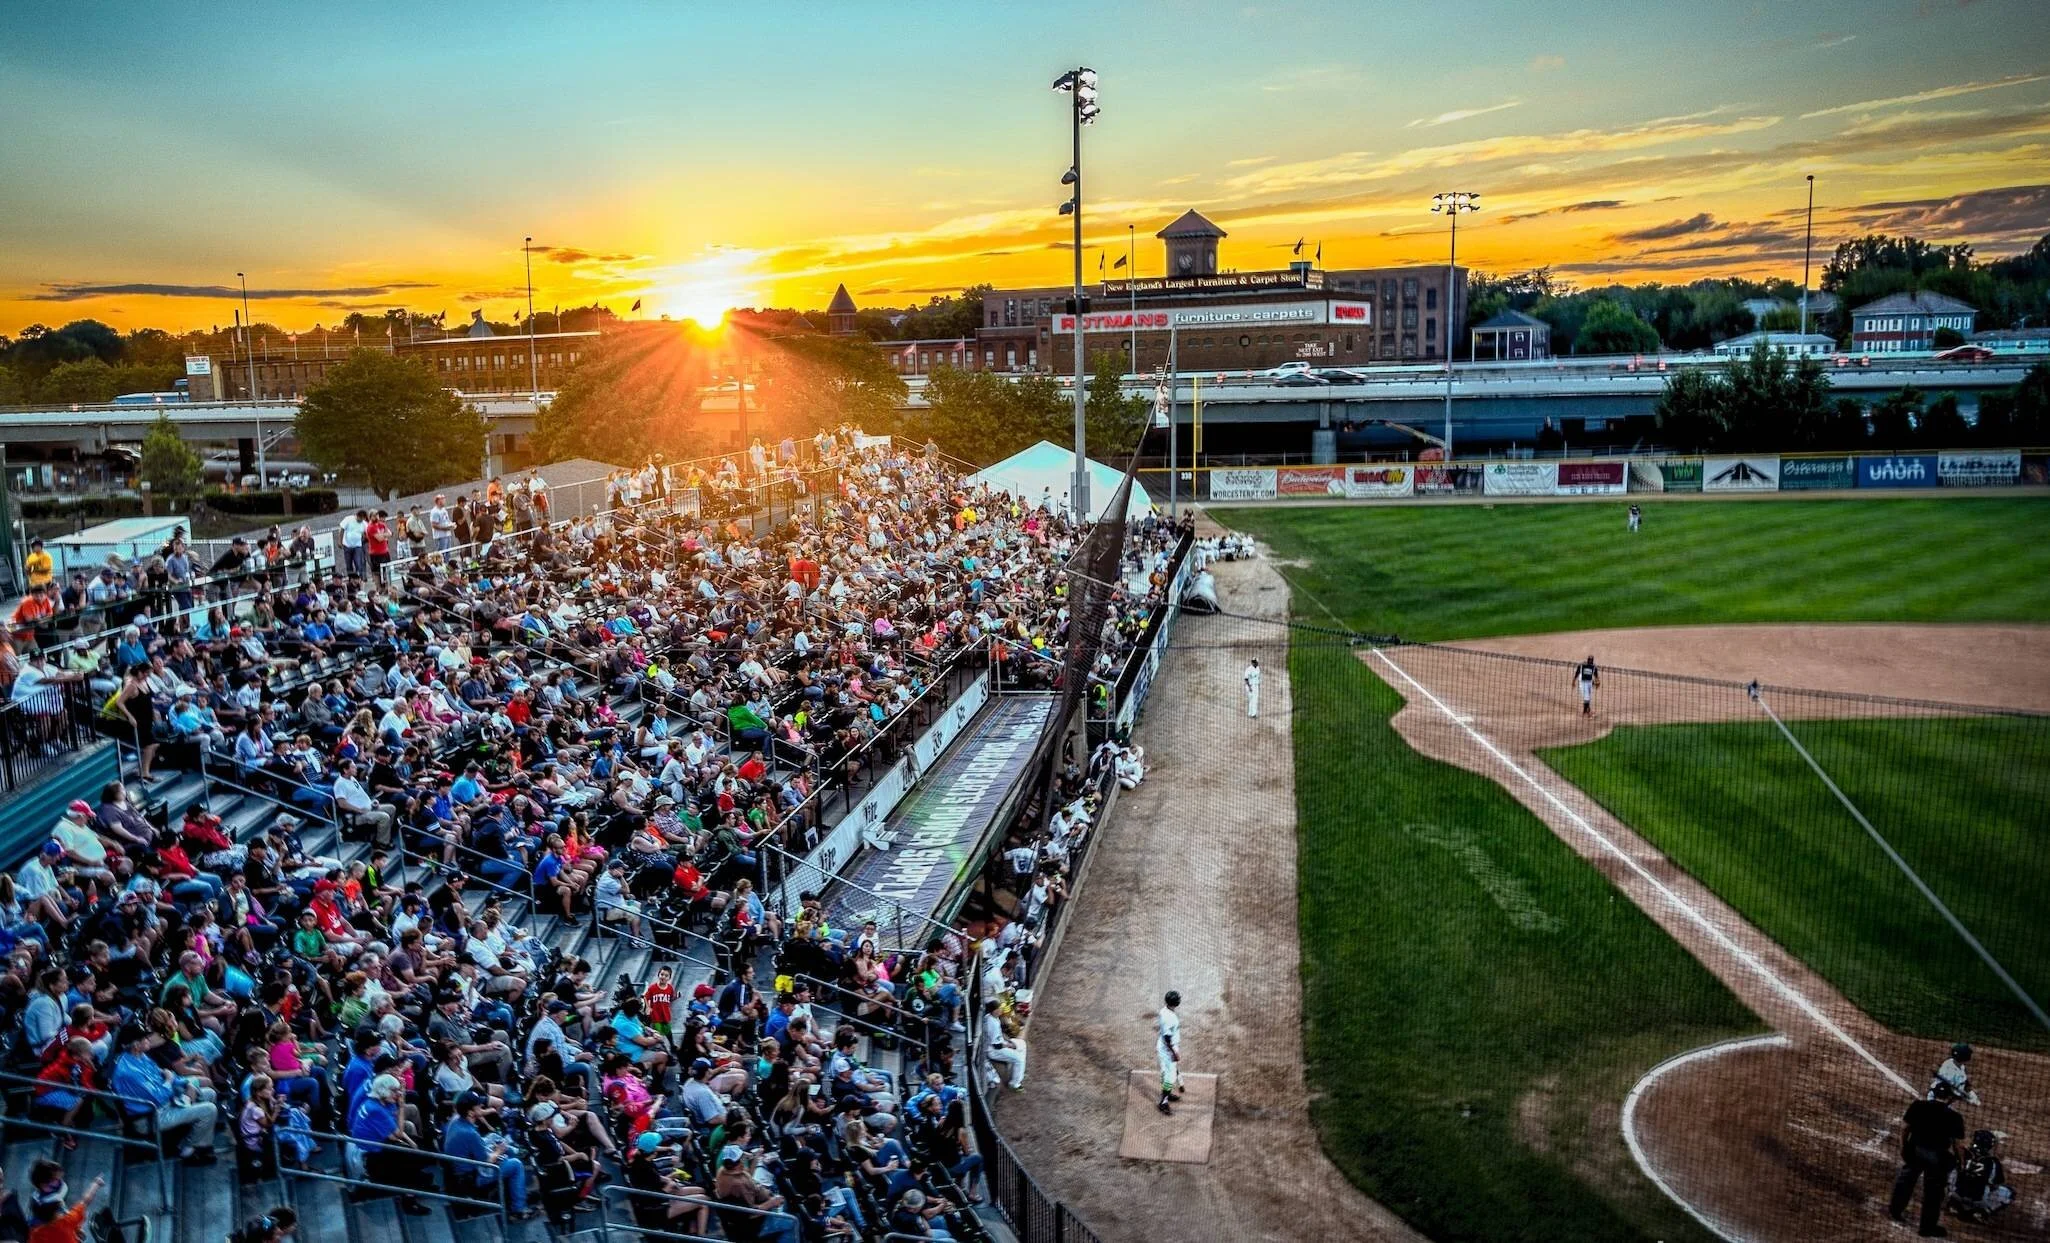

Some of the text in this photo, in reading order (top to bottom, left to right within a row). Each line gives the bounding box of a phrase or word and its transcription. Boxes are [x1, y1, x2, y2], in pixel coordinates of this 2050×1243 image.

[1107, 282, 1123, 292] New
[1125, 280, 1162, 291] England's
[1165, 279, 1195, 290] Largest
[1197, 277, 1237, 288] Furniture
[1239, 276, 1248, 285] &
[1250, 274, 1278, 286] Carpet
[1280, 272, 1301, 282] Store
[1175, 311, 1241, 323] furniture
[1253, 308, 1314, 321] carpets
[1869, 459, 1926, 480] unum
[906, 806, 976, 846] POWER
[872, 849, 945, 900] SUPPLY
